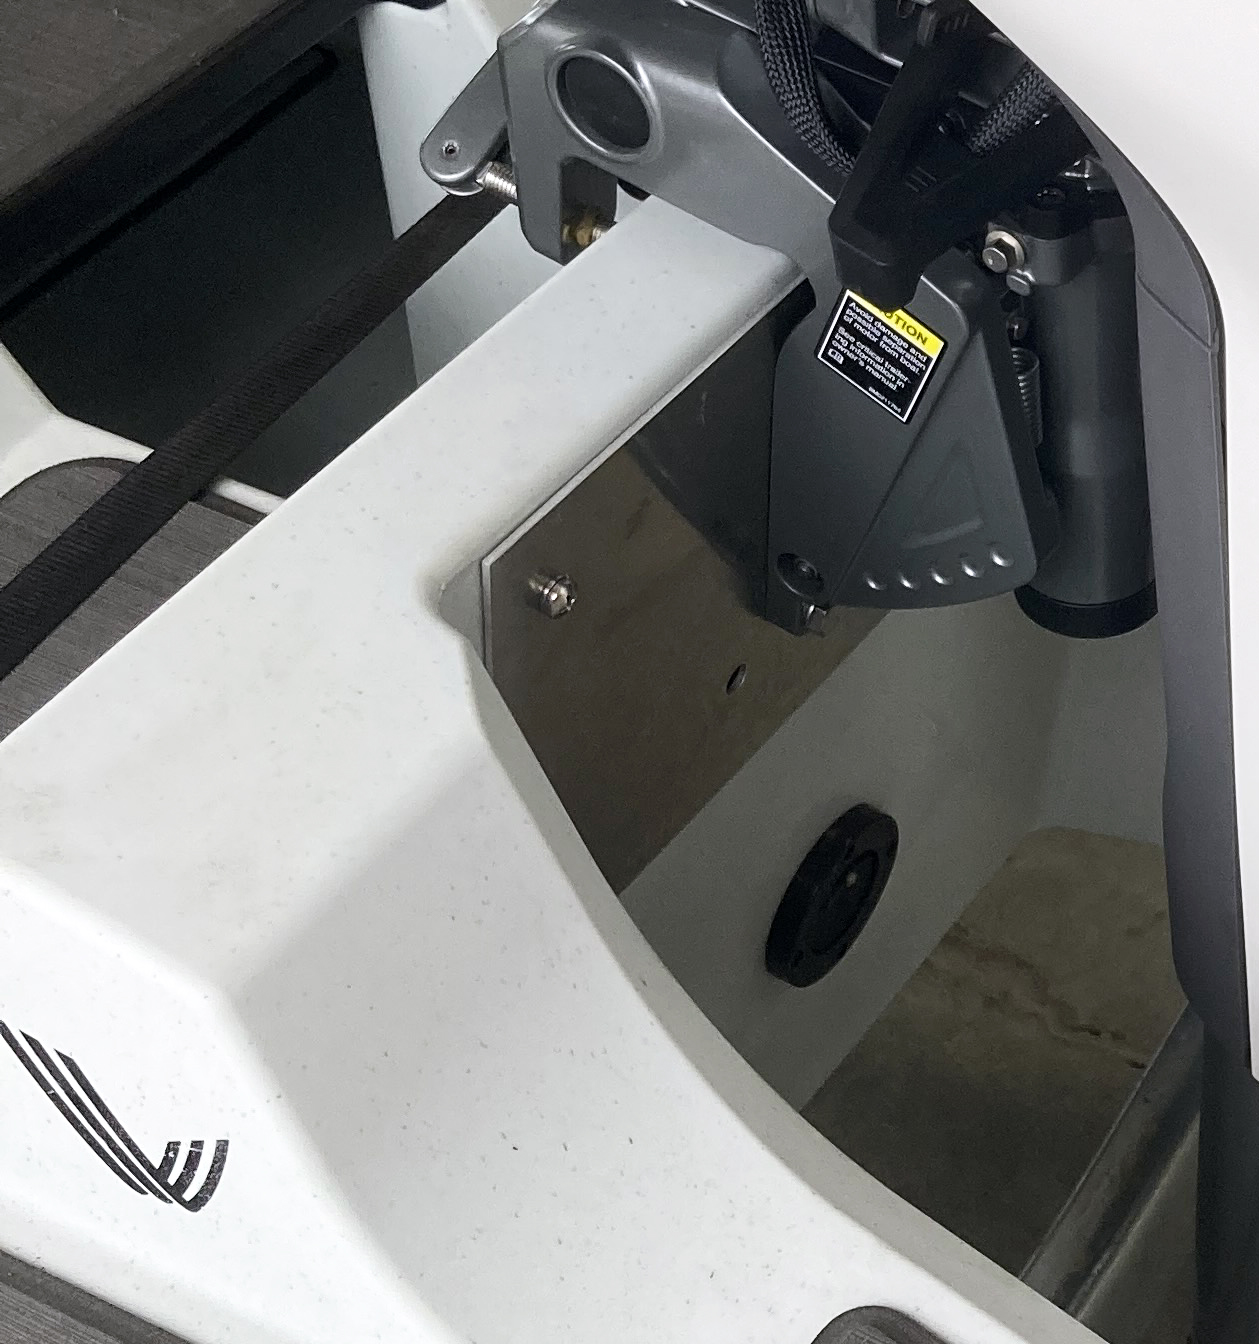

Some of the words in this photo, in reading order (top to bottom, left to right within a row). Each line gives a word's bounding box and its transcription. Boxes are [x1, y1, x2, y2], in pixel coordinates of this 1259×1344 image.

[838, 326, 856, 343] See
[856, 341, 884, 364] critical
[843, 315, 854, 324] of
[853, 322, 878, 343] motor
[879, 340, 899, 359] from
[846, 308, 881, 337] possible
[882, 335, 926, 370] separation
[849, 302, 874, 323] Avoid
[874, 321, 909, 349] damage
[910, 346, 928, 362] and
[883, 311, 928, 346] UTION
[832, 340, 865, 367] owner's
[834, 333, 849, 347] ing
[849, 344, 896, 382] information
[896, 378, 905, 389] in
